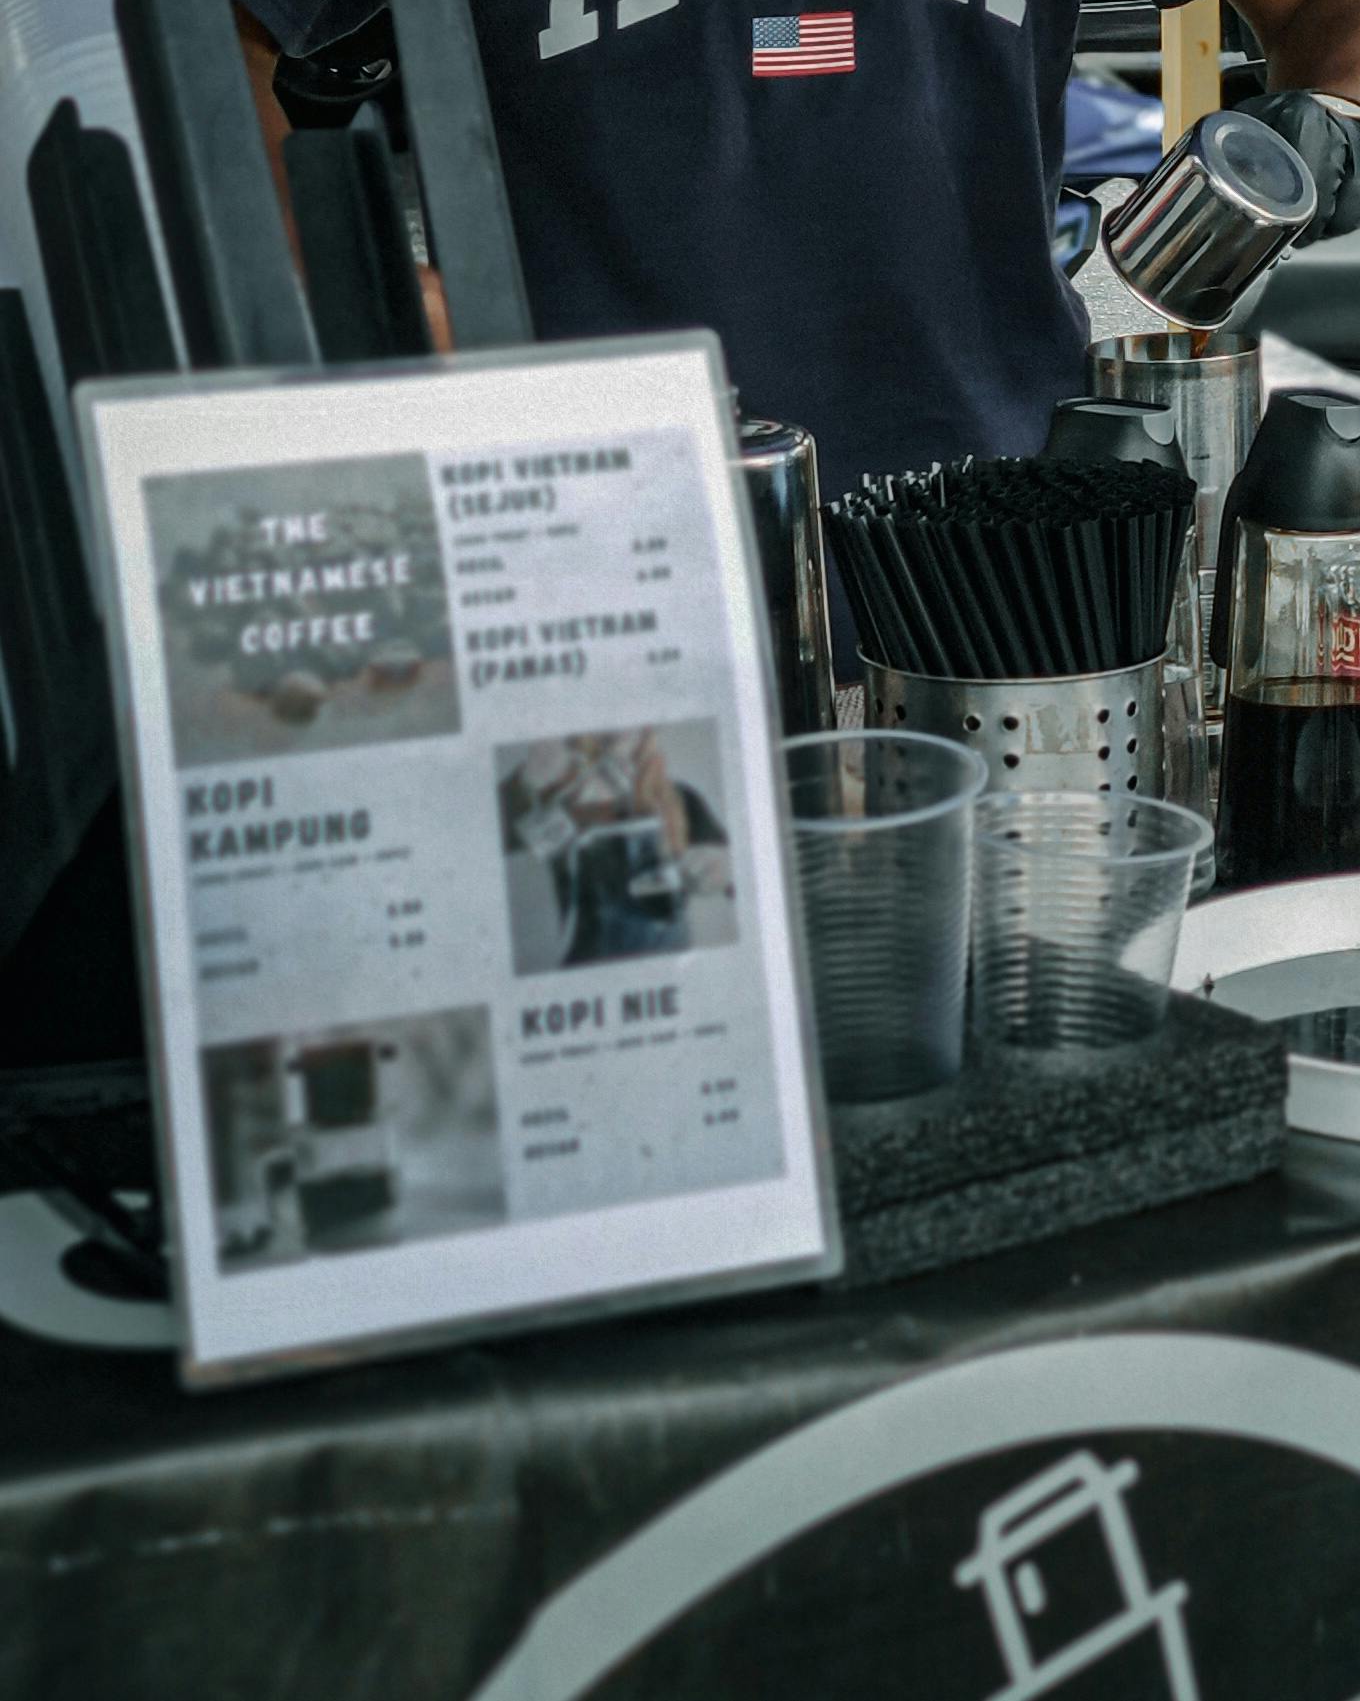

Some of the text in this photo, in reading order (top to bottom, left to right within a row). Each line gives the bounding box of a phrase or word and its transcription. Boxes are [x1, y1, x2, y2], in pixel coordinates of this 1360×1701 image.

[260, 514, 327, 545] THE
[188, 554, 411, 606] VIETNAMESE
[241, 614, 374, 655] COFFEE
[185, 776, 274, 818] KOPI
[189, 809, 372, 863] KAMPUNG
[521, 985, 680, 1039] KOPI NIE
